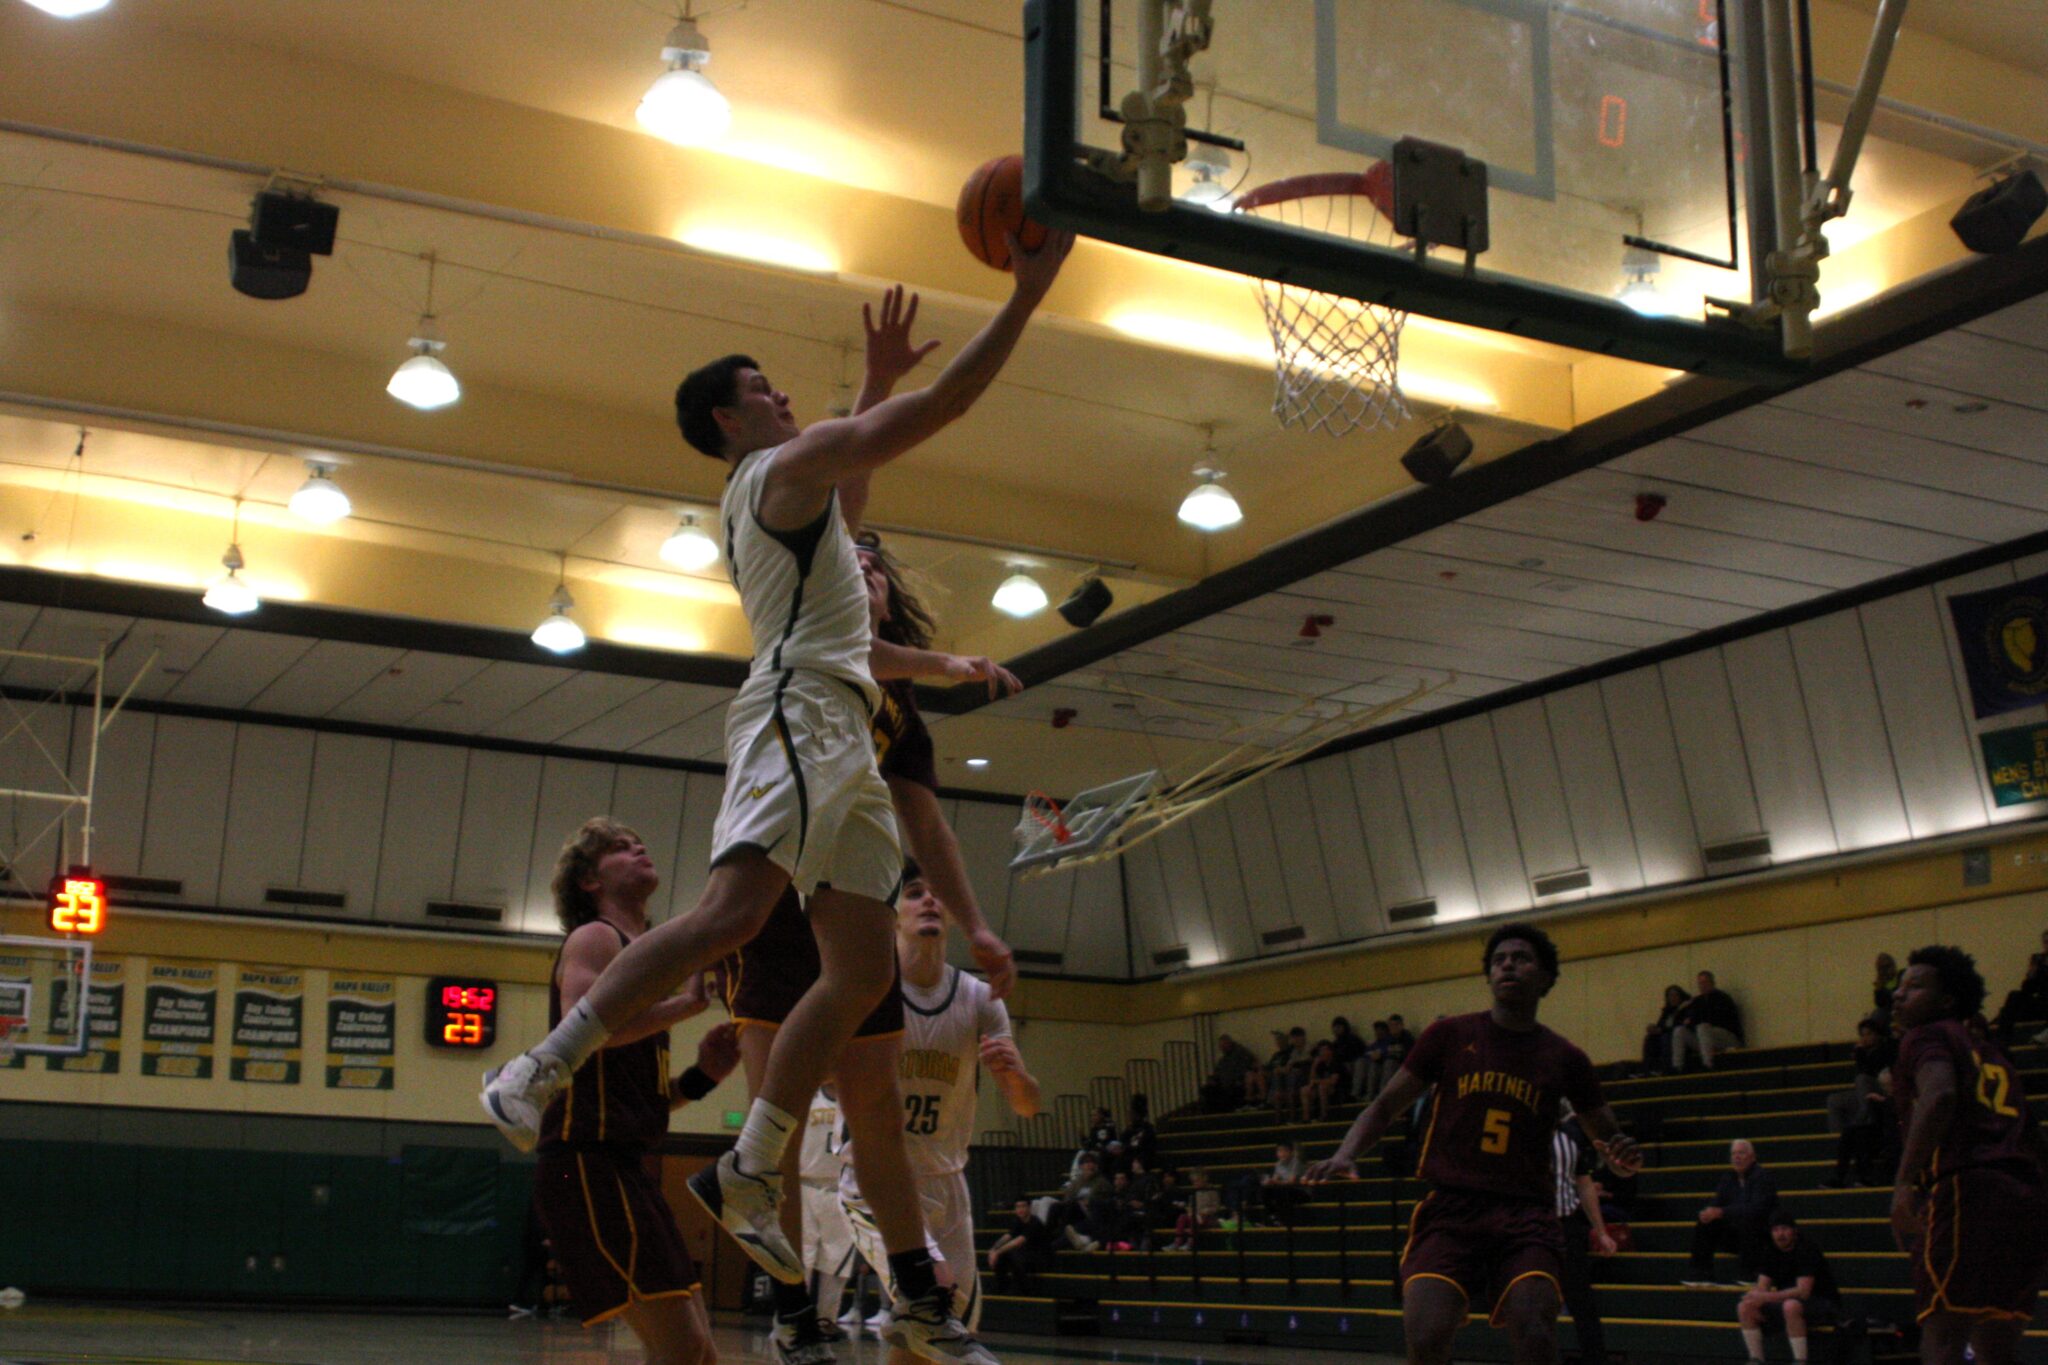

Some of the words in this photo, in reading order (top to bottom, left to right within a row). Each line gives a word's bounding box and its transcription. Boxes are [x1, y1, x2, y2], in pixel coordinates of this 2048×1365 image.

[52, 893, 100, 931] 23
[442, 986, 495, 1011] 19:52
[444, 1012, 482, 1043] 23
[1457, 1071, 1542, 1113] HARTNELL
[905, 1094, 941, 1135] 25
[1479, 1107, 1513, 1155] 5
